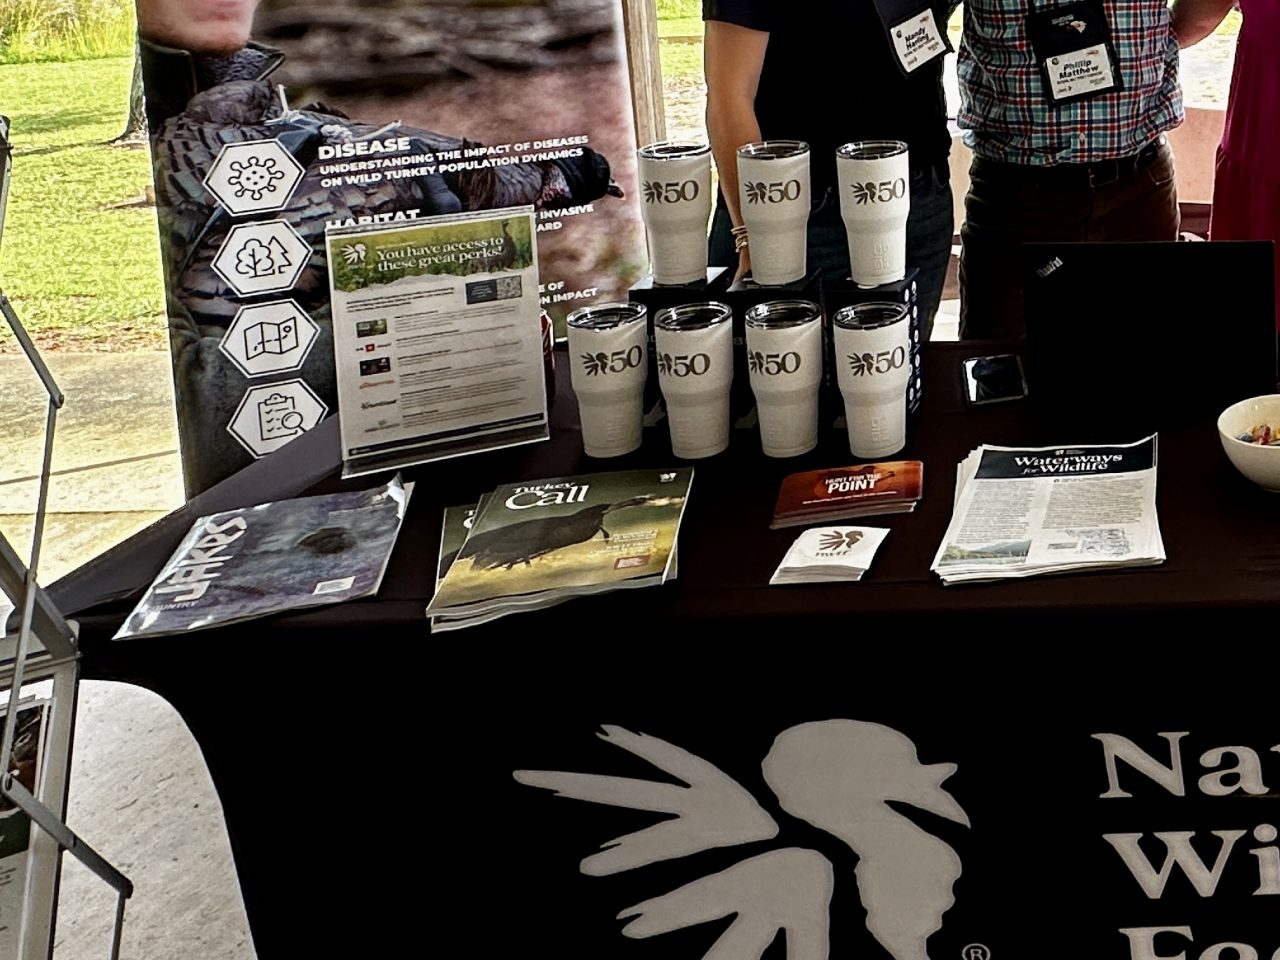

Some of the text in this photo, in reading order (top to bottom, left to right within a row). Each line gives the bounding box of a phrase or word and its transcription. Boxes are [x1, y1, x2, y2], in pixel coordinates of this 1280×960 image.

[1059, 65, 1099, 79] Matthew
[318, 137, 411, 160] DISEASE
[320, 135, 589, 175] UNDERSTANDING THE IMPACT OF DISEASES
[321, 147, 584, 188] ON WILD TURKEY POPULATION DYNAMICS
[664, 179, 699, 204] 50
[766, 179, 801, 204] 50
[875, 177, 906, 204] 50
[540, 204, 594, 220] INVASIVE
[377, 237, 504, 261] You have access to
[377, 260, 417, 272] these
[419, 254, 455, 269] great
[548, 281, 565, 291] OF
[553, 287, 598, 303] IMPACT
[609, 345, 643, 373] 50
[672, 352, 711, 377] 50
[764, 351, 801, 376] 50
[875, 346, 906, 374] 50
[1015, 454, 1123, 466] Waterways
[1040, 462, 1109, 473] Wildlife
[505, 484, 590, 510] Call
[827, 479, 877, 494] POINT
